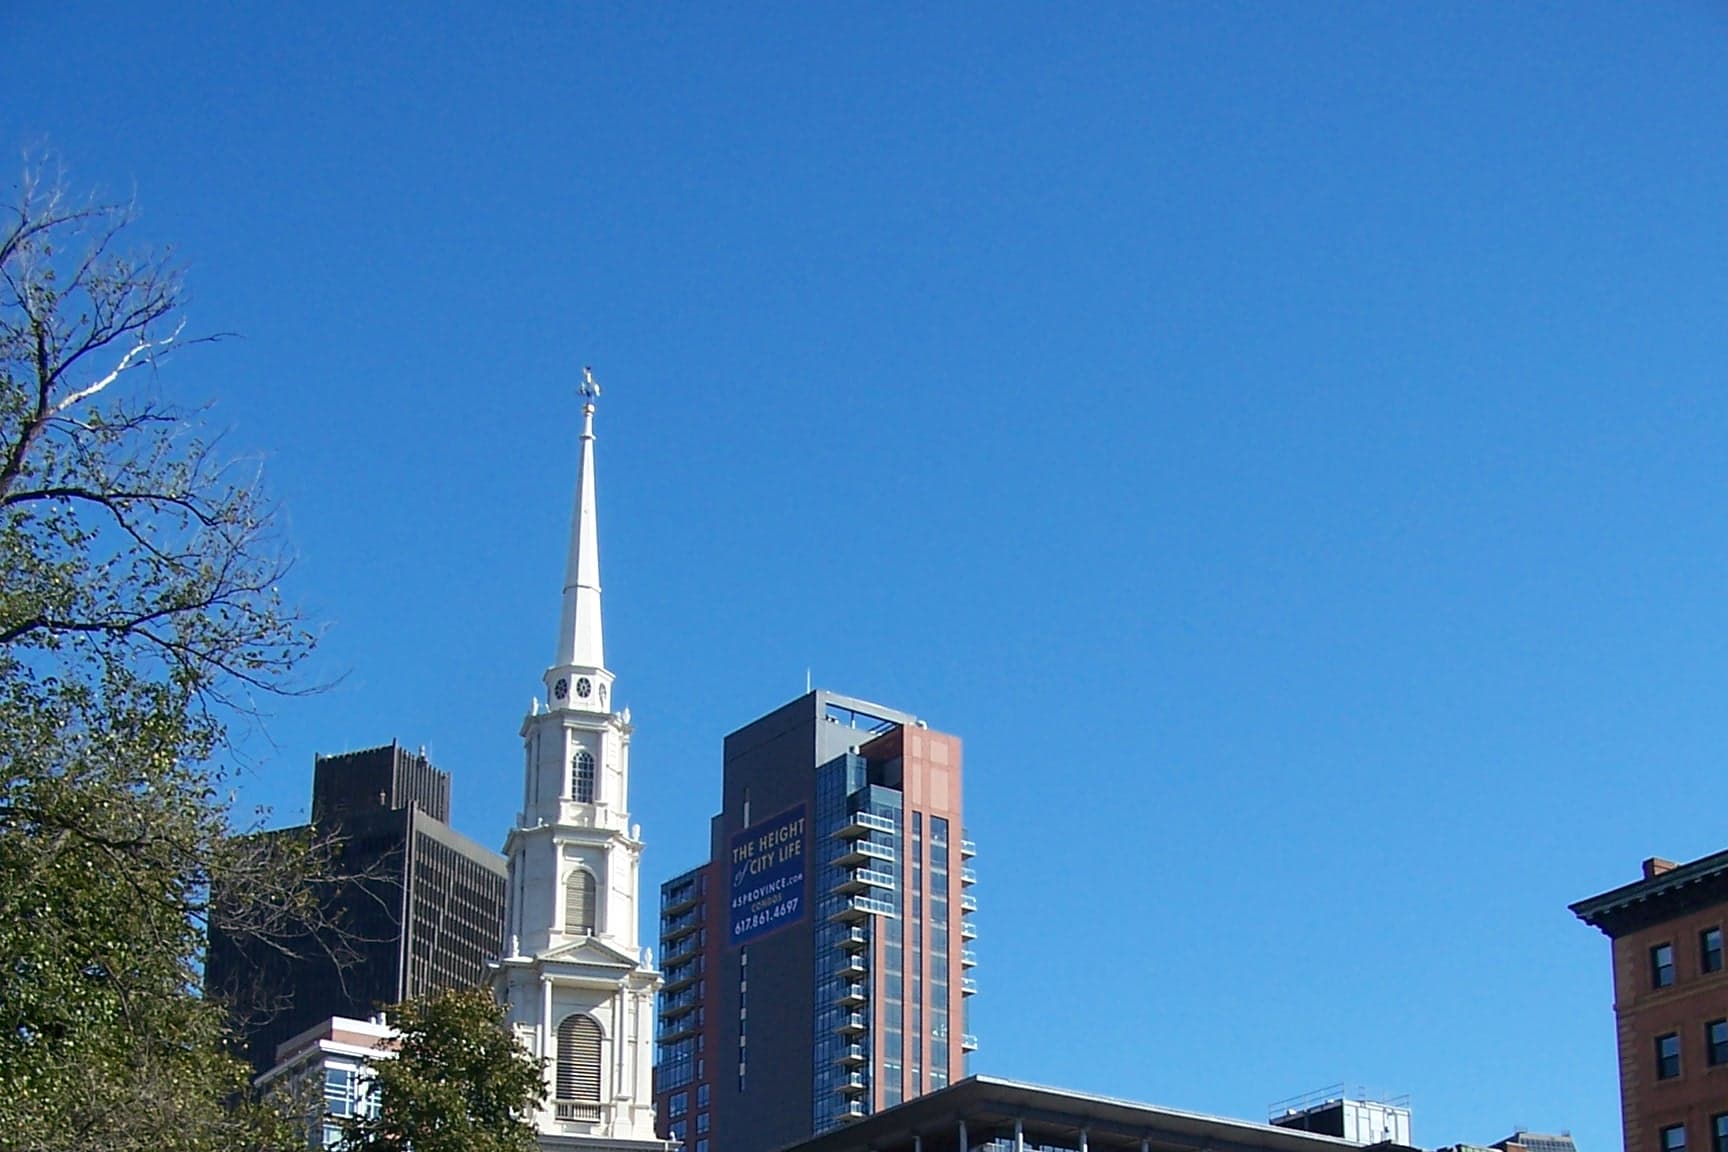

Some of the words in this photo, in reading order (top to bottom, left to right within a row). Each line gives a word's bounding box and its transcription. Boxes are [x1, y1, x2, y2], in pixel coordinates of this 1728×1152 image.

[733, 841, 754, 864] THE
[759, 818, 805, 851] HEIGHT
[750, 852, 774, 875] CITY
[779, 839, 801, 862] LIFE
[734, 897, 799, 935] 617.861.4697
